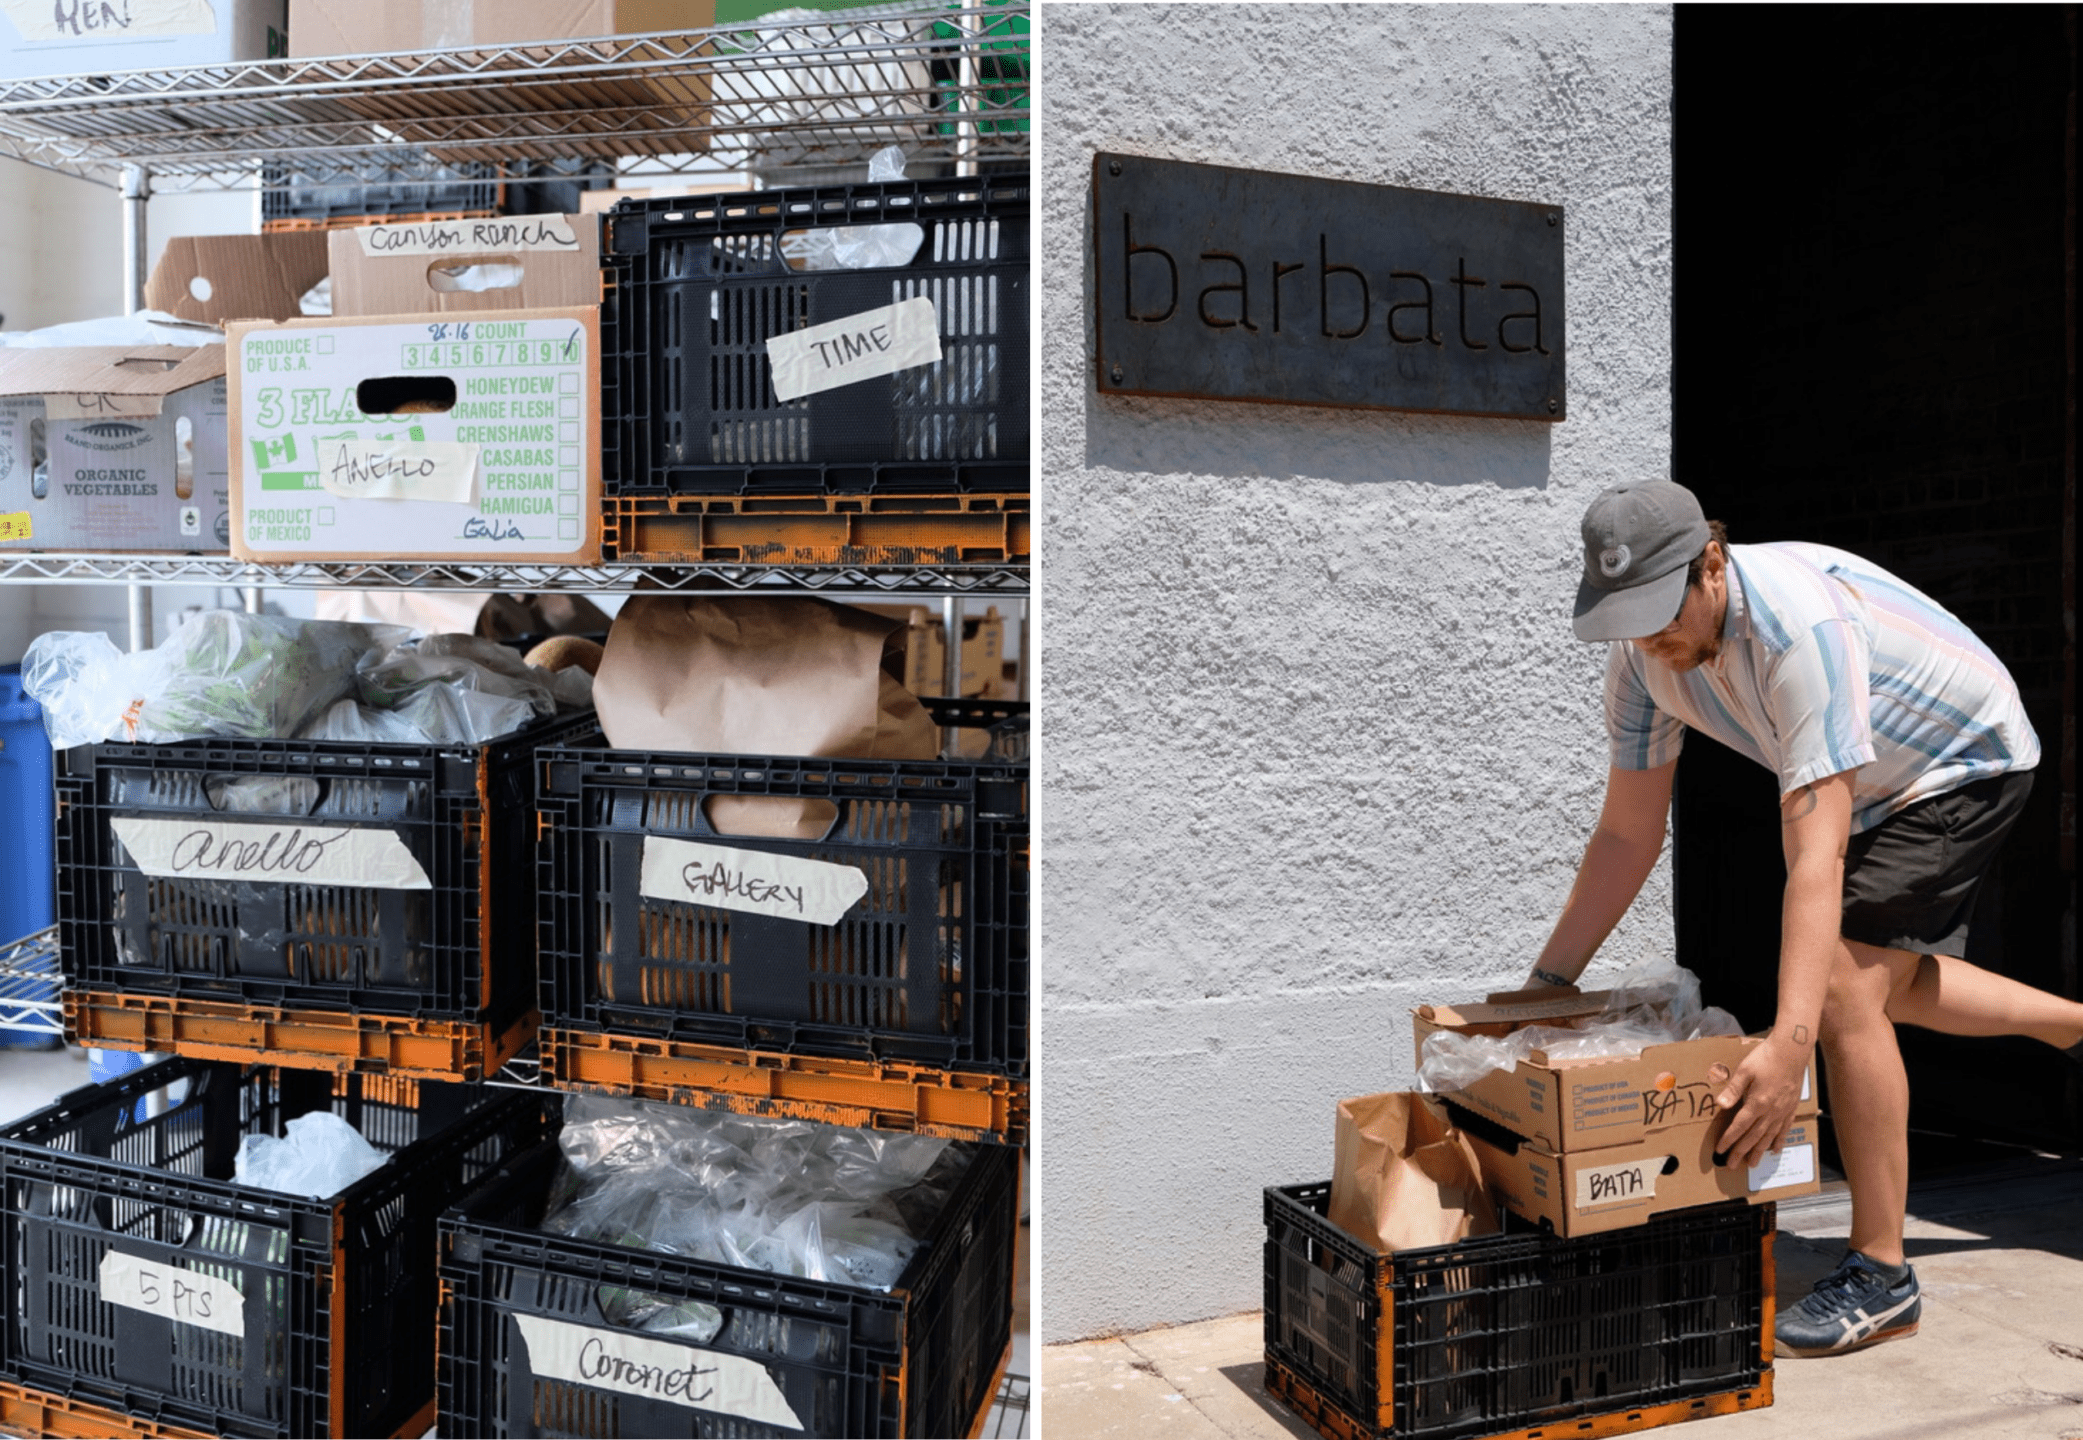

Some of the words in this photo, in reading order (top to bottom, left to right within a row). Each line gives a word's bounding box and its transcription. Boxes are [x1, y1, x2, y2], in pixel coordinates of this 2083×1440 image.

[1124, 212, 1551, 355] barbata
[475, 322, 528, 339] COUNT
[246, 338, 312, 356] PRODUCE
[407, 347, 418, 366] 3
[429, 346, 440, 365] 4
[451, 345, 462, 365] 5
[473, 344, 484, 364] 6
[495, 344, 506, 363] 7
[517, 343, 528, 363] 8
[540, 342, 551, 362] 9
[810, 324, 892, 369] TIME
[247, 357, 264, 373] OF
[268, 356, 311, 372] U.S.A.
[466, 376, 554, 396] HONEYDEW
[257, 387, 285, 429] 3
[450, 401, 506, 419] ORANGE
[511, 400, 554, 418] FLESH
[457, 424, 554, 443] CRENSHAWS
[331, 443, 435, 484] ANELLO
[483, 448, 554, 467] CASABAS
[74, 469, 146, 482] ORGANIC
[486, 472, 554, 491] PERSIAN
[64, 483, 158, 496] VEGETABLES
[480, 497, 554, 515] HAMIGUA
[250, 508, 312, 525] PRODUCT
[250, 526, 266, 541] OF
[267, 525, 312, 541] MEXICO
[682, 861, 803, 913] GALLERY
[1642, 1082, 1718, 1125] BATA
[1589, 1167, 1643, 1201] BATA
[139, 1269, 160, 1305] 5
[579, 1337, 719, 1401] Coronet
